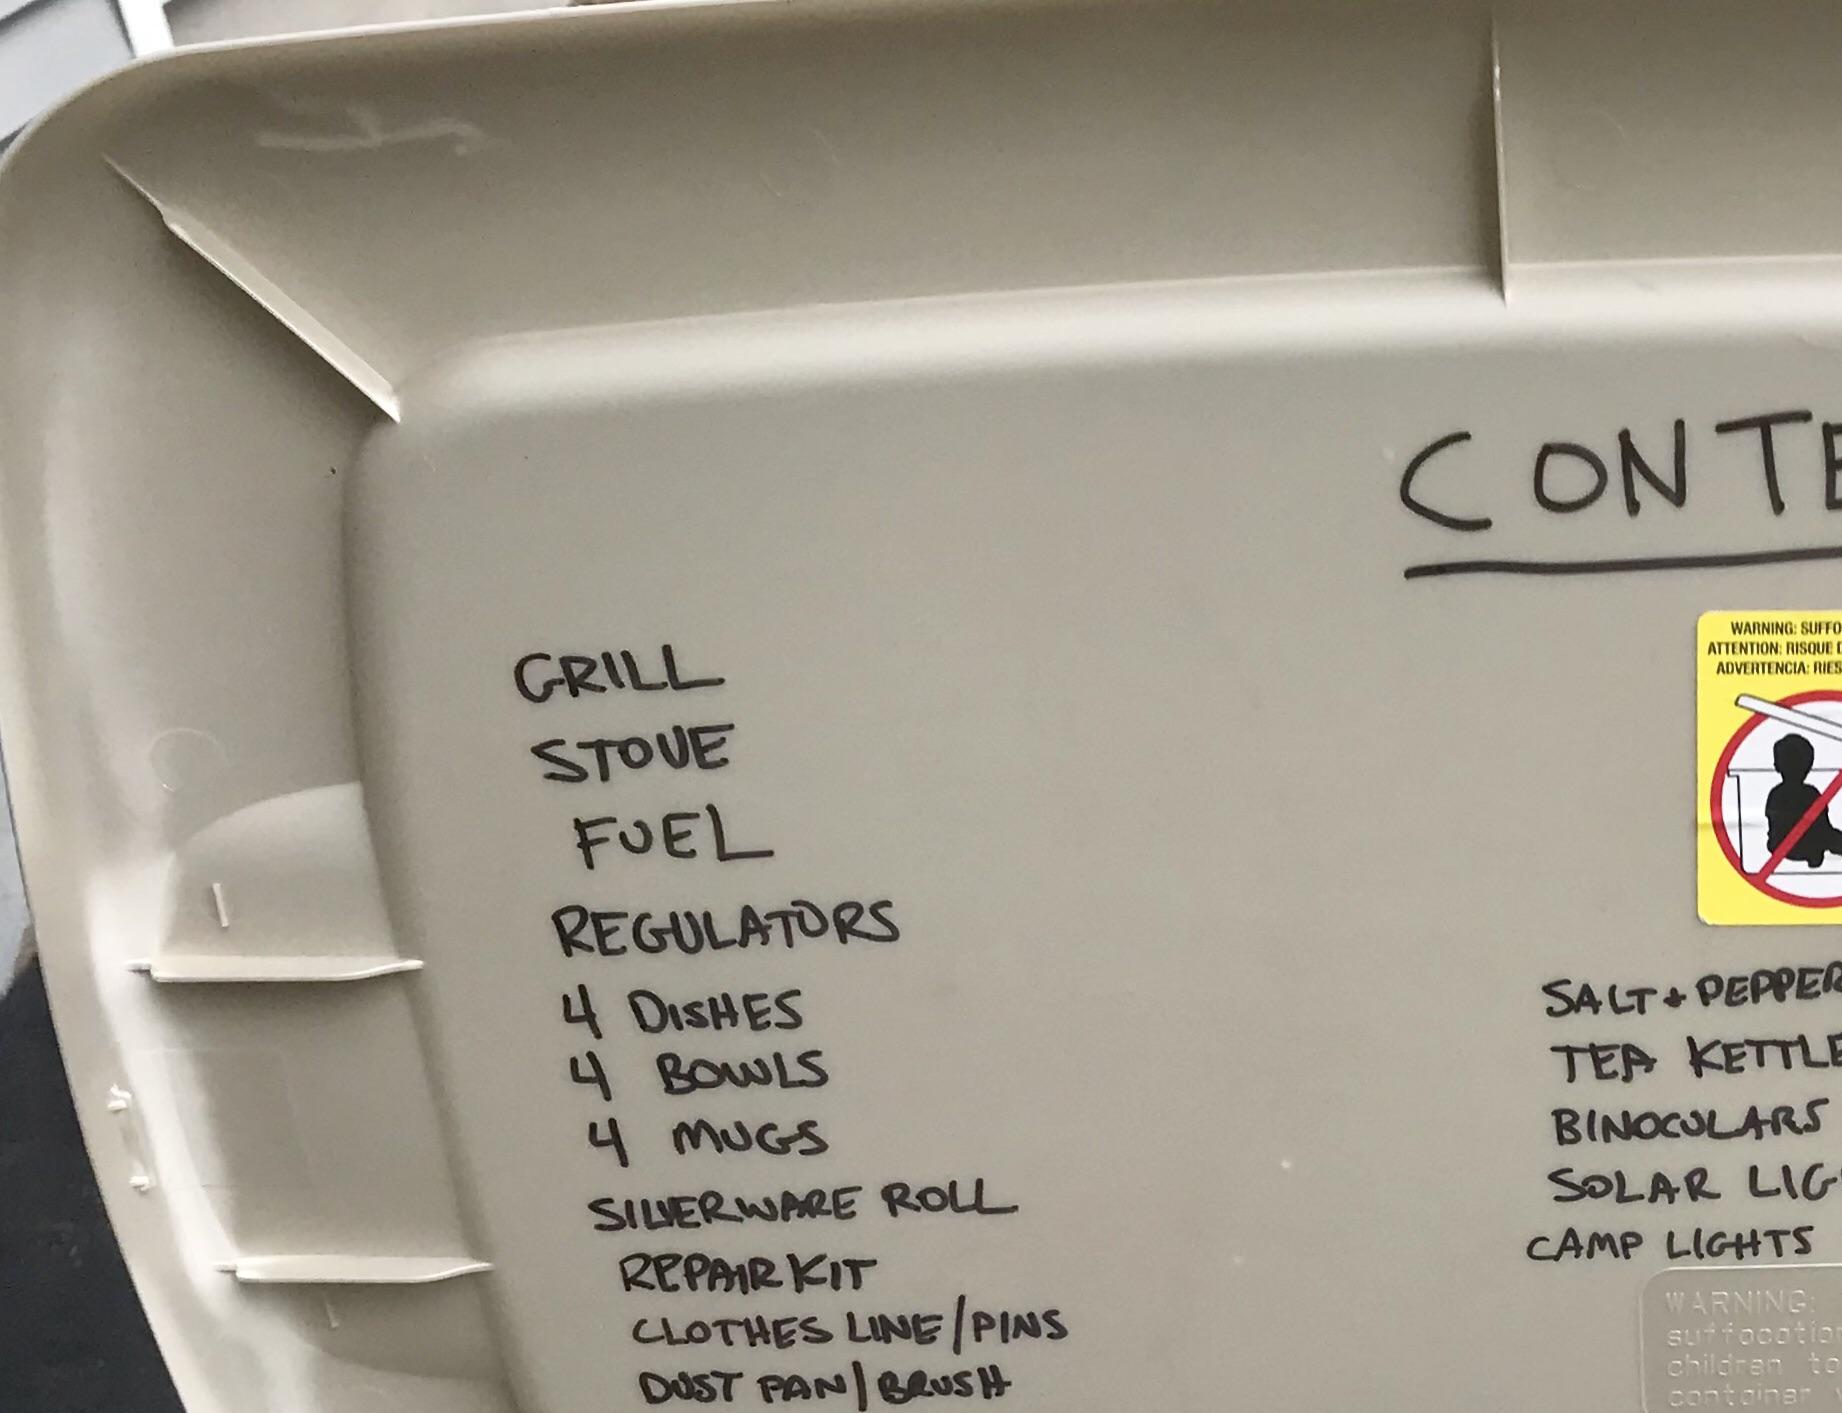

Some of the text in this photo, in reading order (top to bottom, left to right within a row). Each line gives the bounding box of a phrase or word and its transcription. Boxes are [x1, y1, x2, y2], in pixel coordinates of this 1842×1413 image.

[1707, 641, 1782, 656] ATTENTION:
[1786, 641, 1833, 655] RISQUE
[1731, 621, 1797, 636] WARNING:
[514, 644, 725, 703] GRILL
[1716, 661, 1810, 676] ADVERTENCIA:
[530, 723, 735, 783] STOVE
[573, 804, 774, 870] FUEL
[551, 899, 900, 958] REGULATORS
[562, 984, 802, 1040] 4 DISHES
[570, 1050, 829, 1102] 4 BOWLS
[1550, 1042, 1657, 1083] TEA
[588, 1117, 829, 1168] 4 MUGS
[1551, 1098, 1829, 1146] BINOCULARS
[588, 1178, 1019, 1232] SILVERWARE ROLL
[1547, 1167, 1721, 1204] SOLAR
[1526, 1227, 1643, 1262] CAMP
[1666, 1226, 1814, 1260] LIGHTS
[619, 1252, 877, 1295] REPAIR KIT
[1665, 1289, 1816, 1314] WARNING:
[632, 1315, 833, 1349] CLOTHES
[1667, 1353, 1783, 1377] children
[1809, 1351, 1841, 1375] to
[639, 1370, 744, 1404] DUST
[1668, 1383, 1811, 1407] container
